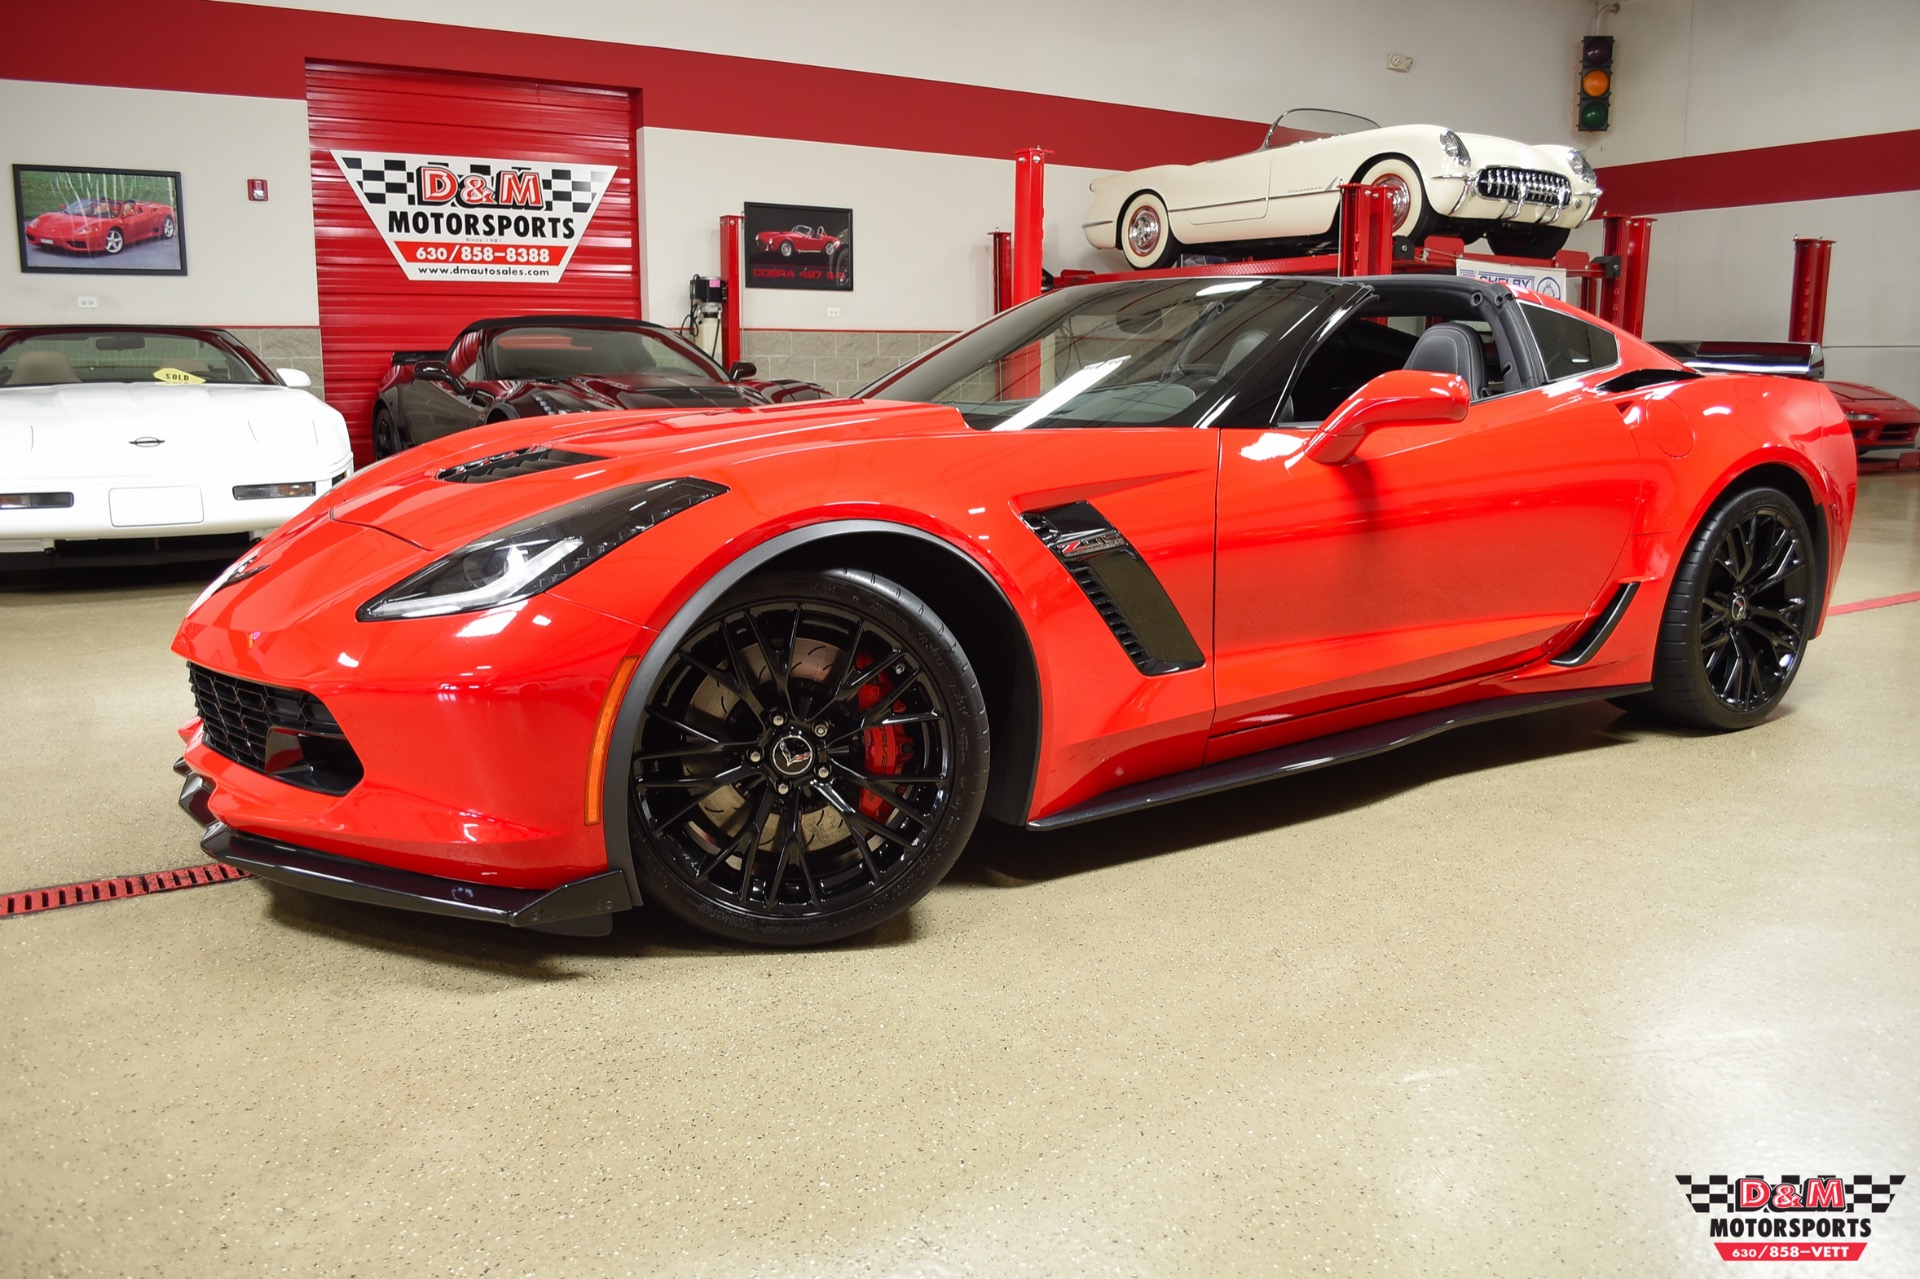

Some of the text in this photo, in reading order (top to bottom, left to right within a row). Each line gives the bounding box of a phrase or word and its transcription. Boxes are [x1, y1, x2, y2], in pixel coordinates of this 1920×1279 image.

[419, 166, 545, 210] D&M
[388, 210, 576, 240] MOTORSPORTS
[416, 244, 550, 263] 630/858-8388
[417, 265, 550, 277] www.dmautosales.com
[165, 373, 190, 381] SOLD
